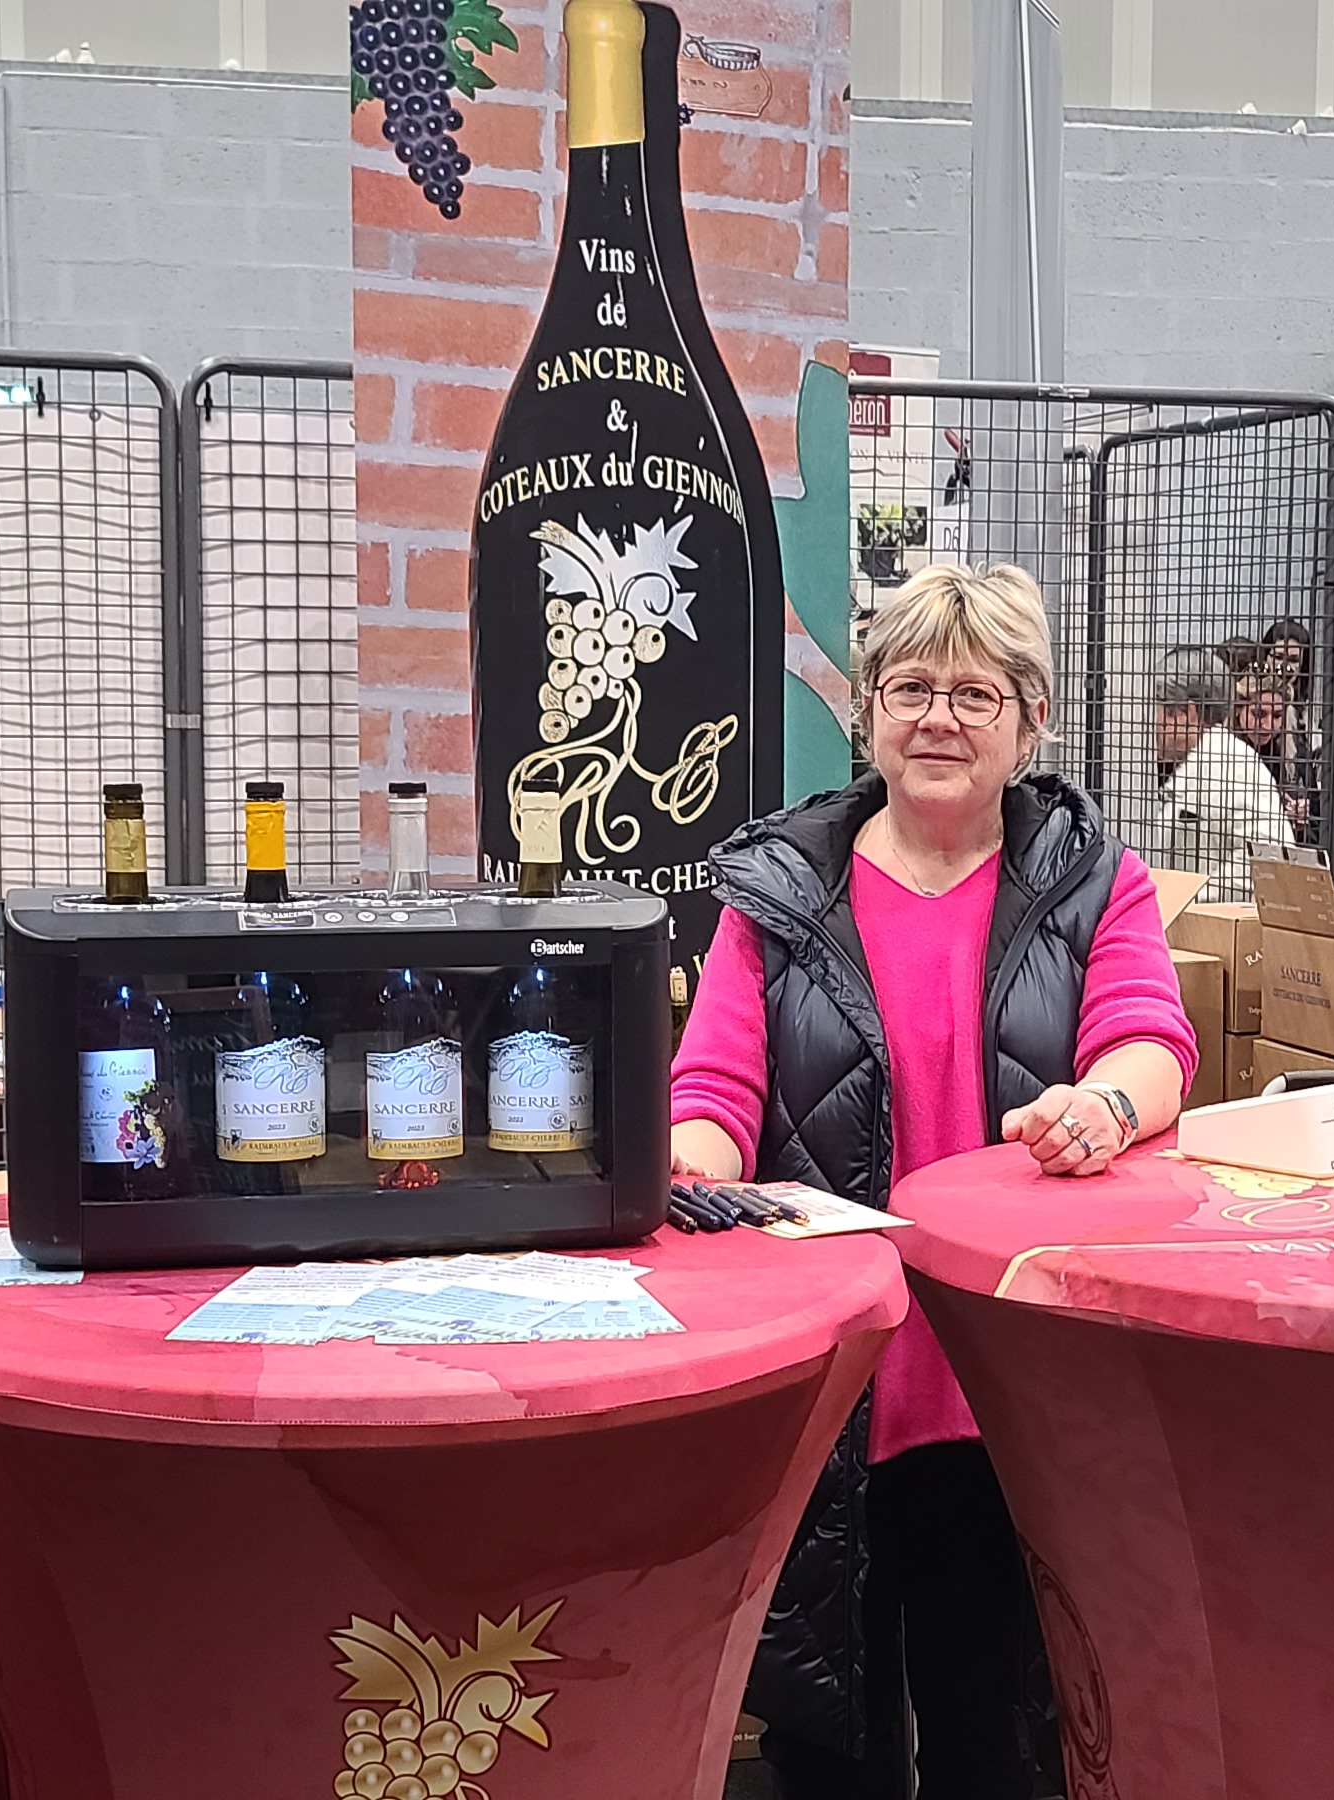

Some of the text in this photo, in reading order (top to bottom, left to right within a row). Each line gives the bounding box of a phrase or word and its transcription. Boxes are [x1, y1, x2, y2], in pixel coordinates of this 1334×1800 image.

[579, 238, 636, 274] Vins
[597, 293, 628, 328] de
[536, 346, 687, 397] SANCERRE
[606, 398, 629, 432] &
[479, 453, 595, 523] COTEAUX
[602, 452, 634, 487] du
[530, 938, 584, 957] Bartscher
[233, 1099, 317, 1115] SANCERRE
[373, 1100, 456, 1115] SANCERRE
